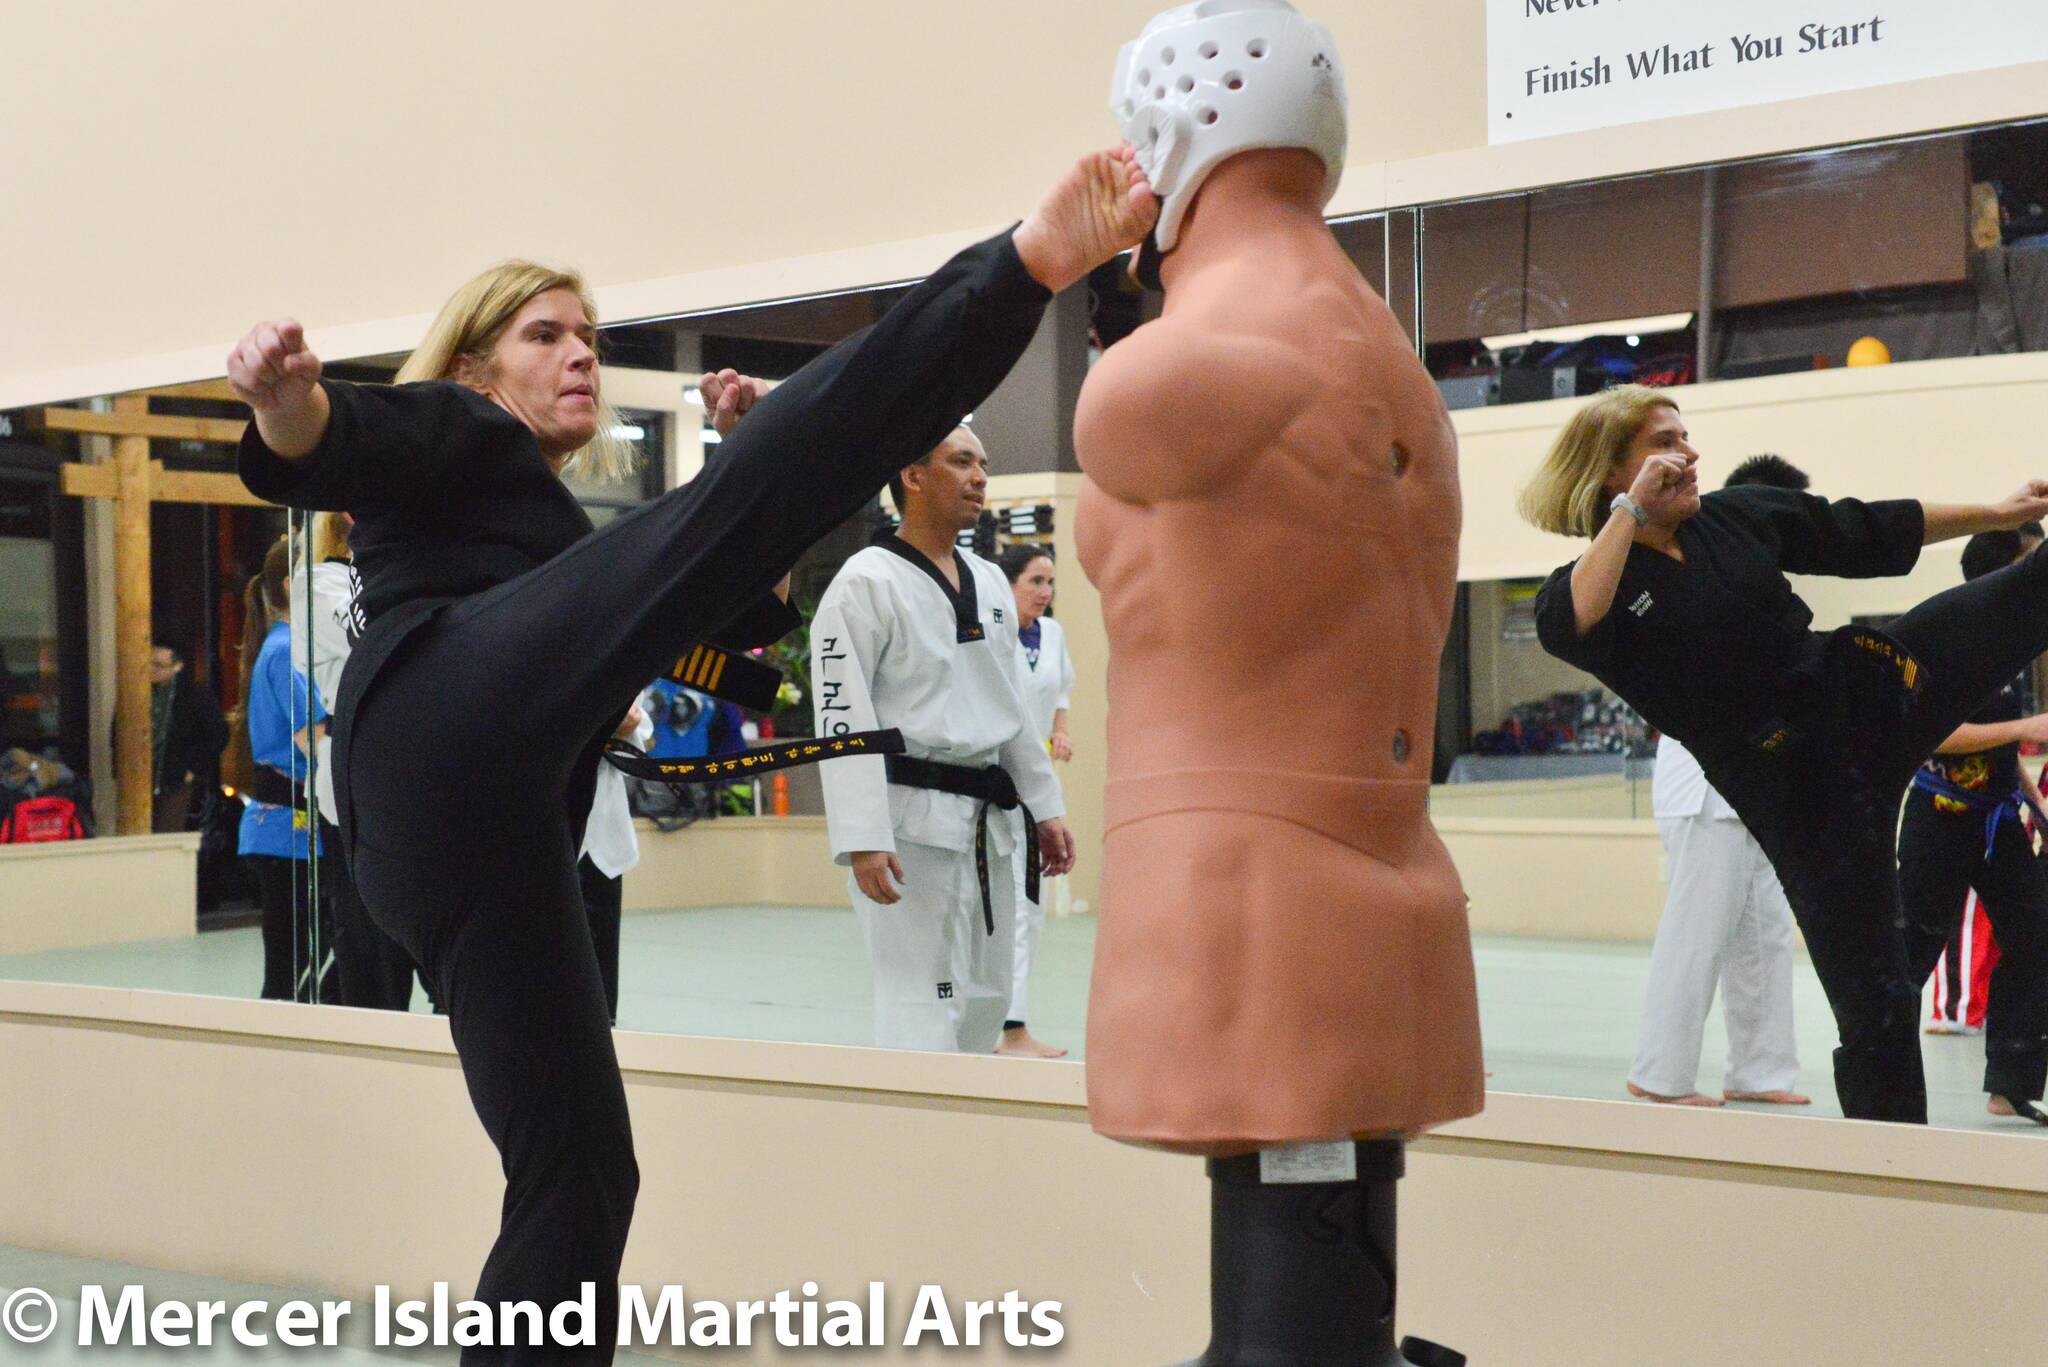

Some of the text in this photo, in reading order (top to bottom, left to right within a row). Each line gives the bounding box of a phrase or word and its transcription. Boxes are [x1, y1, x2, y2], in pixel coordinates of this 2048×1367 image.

[1525, 15, 1885, 96] Finish What You Start
